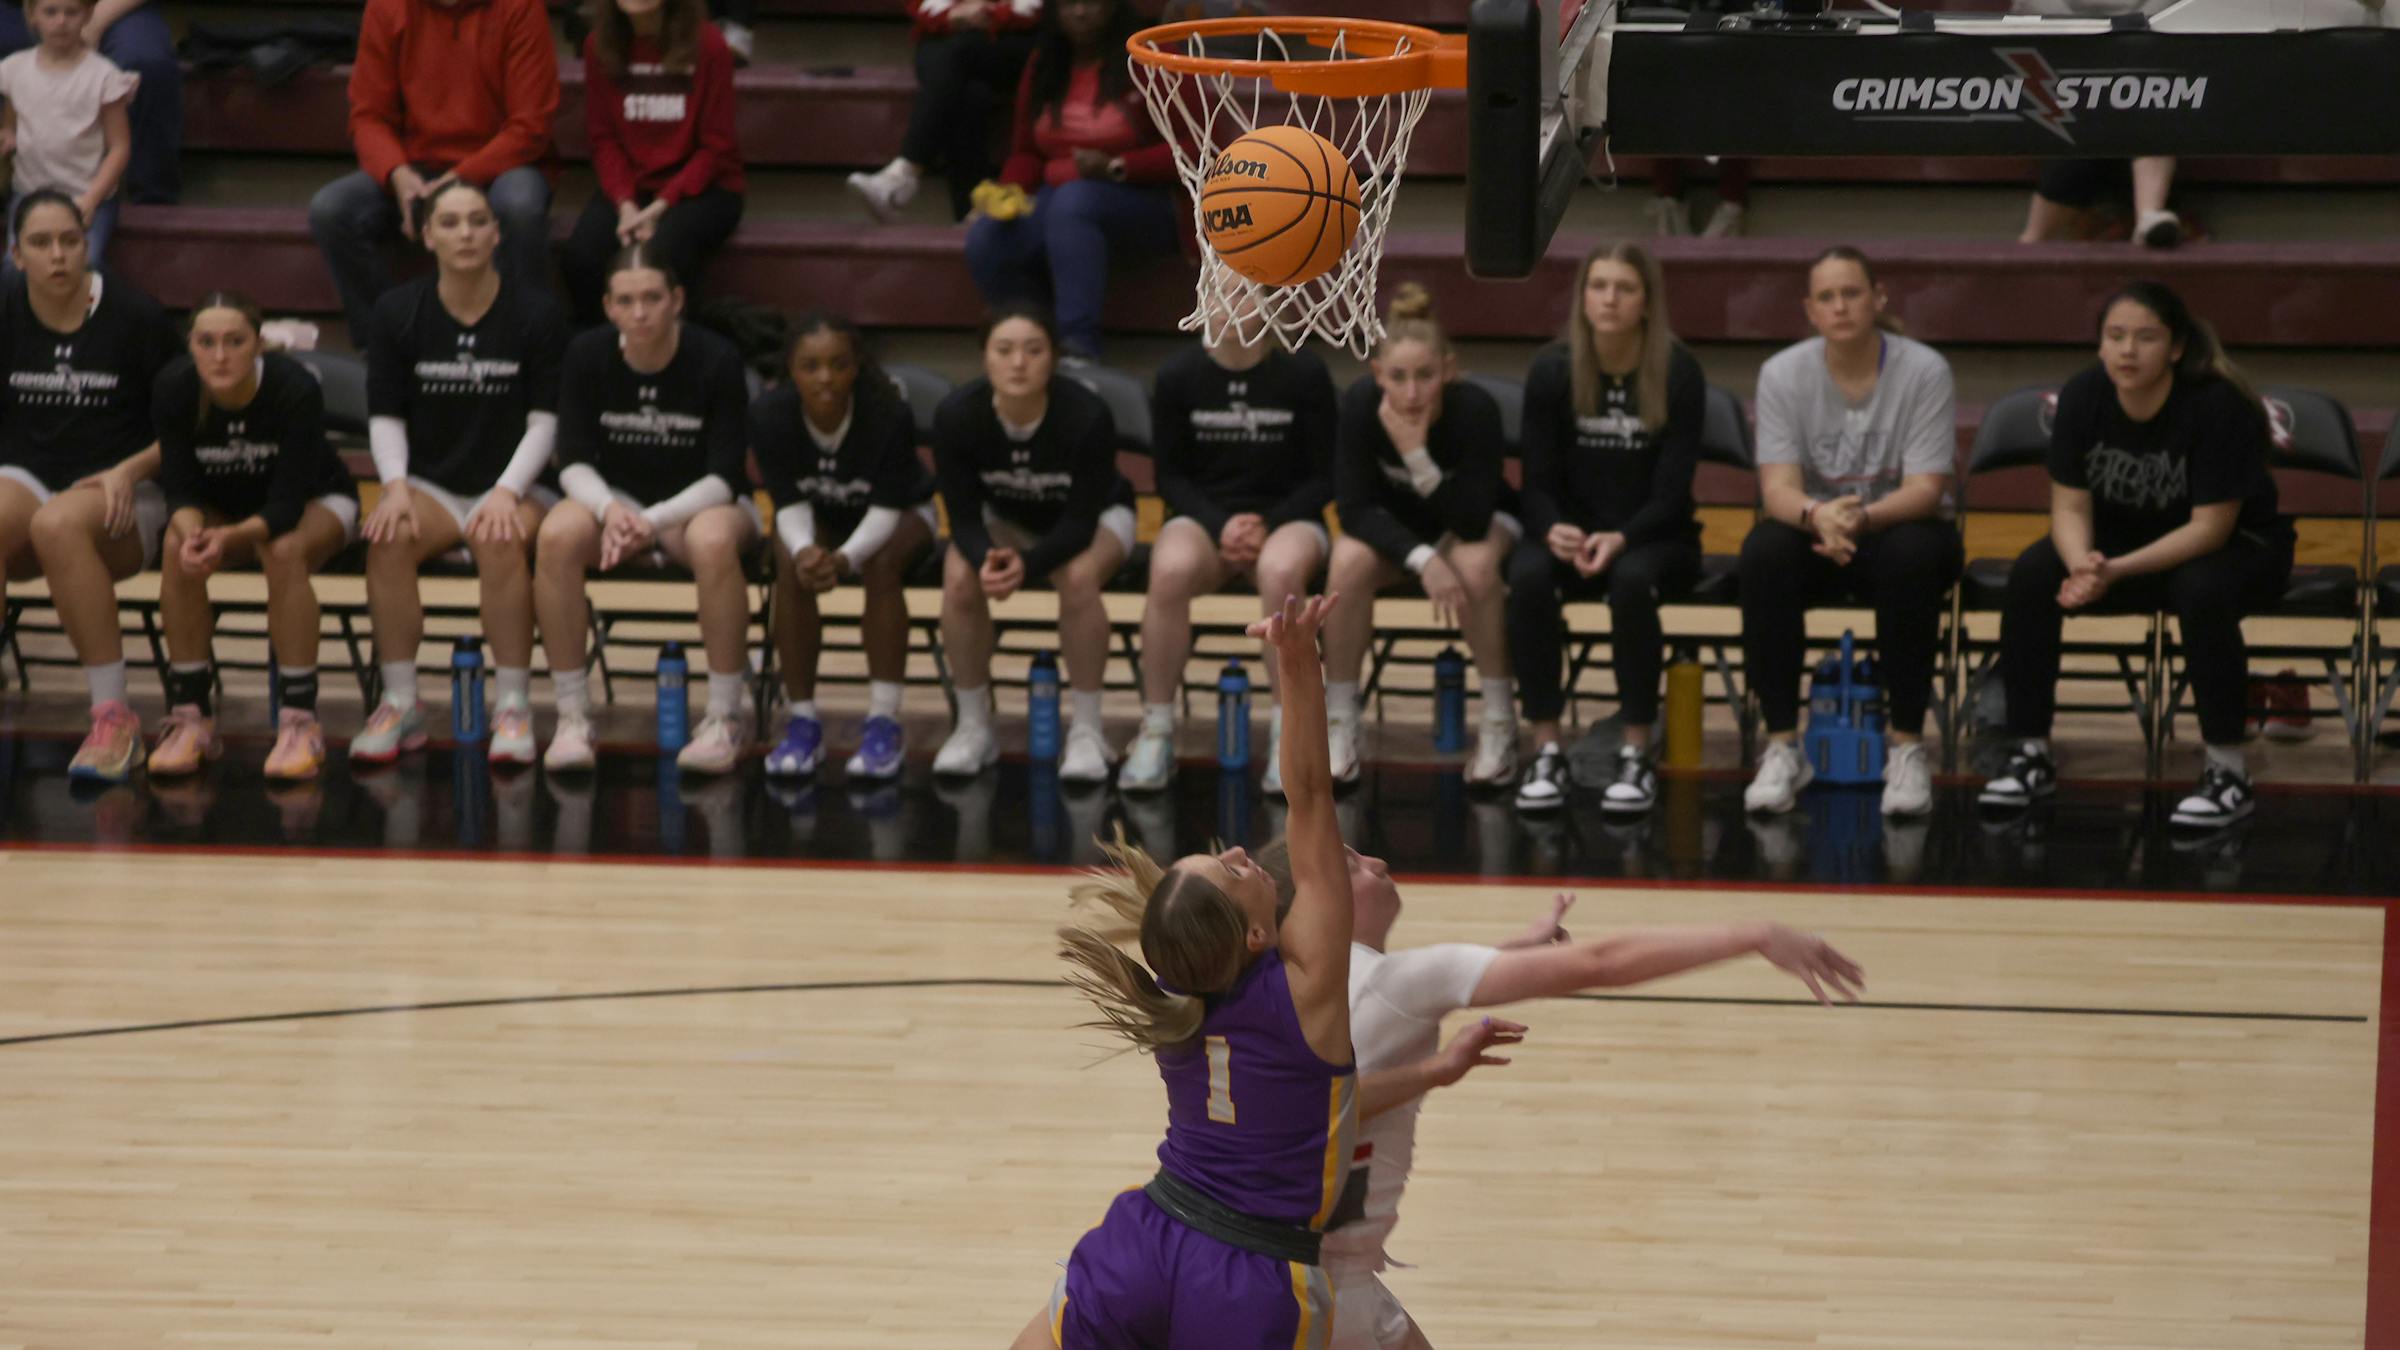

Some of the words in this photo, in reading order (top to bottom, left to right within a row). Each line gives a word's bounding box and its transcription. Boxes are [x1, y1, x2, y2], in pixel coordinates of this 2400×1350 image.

[623, 93, 686, 121] STORM
[1832, 76, 2024, 111] CRIMSON
[2055, 75, 2208, 110] STORM
[1203, 204, 1253, 232] NCAA
[1205, 1035, 1236, 1125] 1
